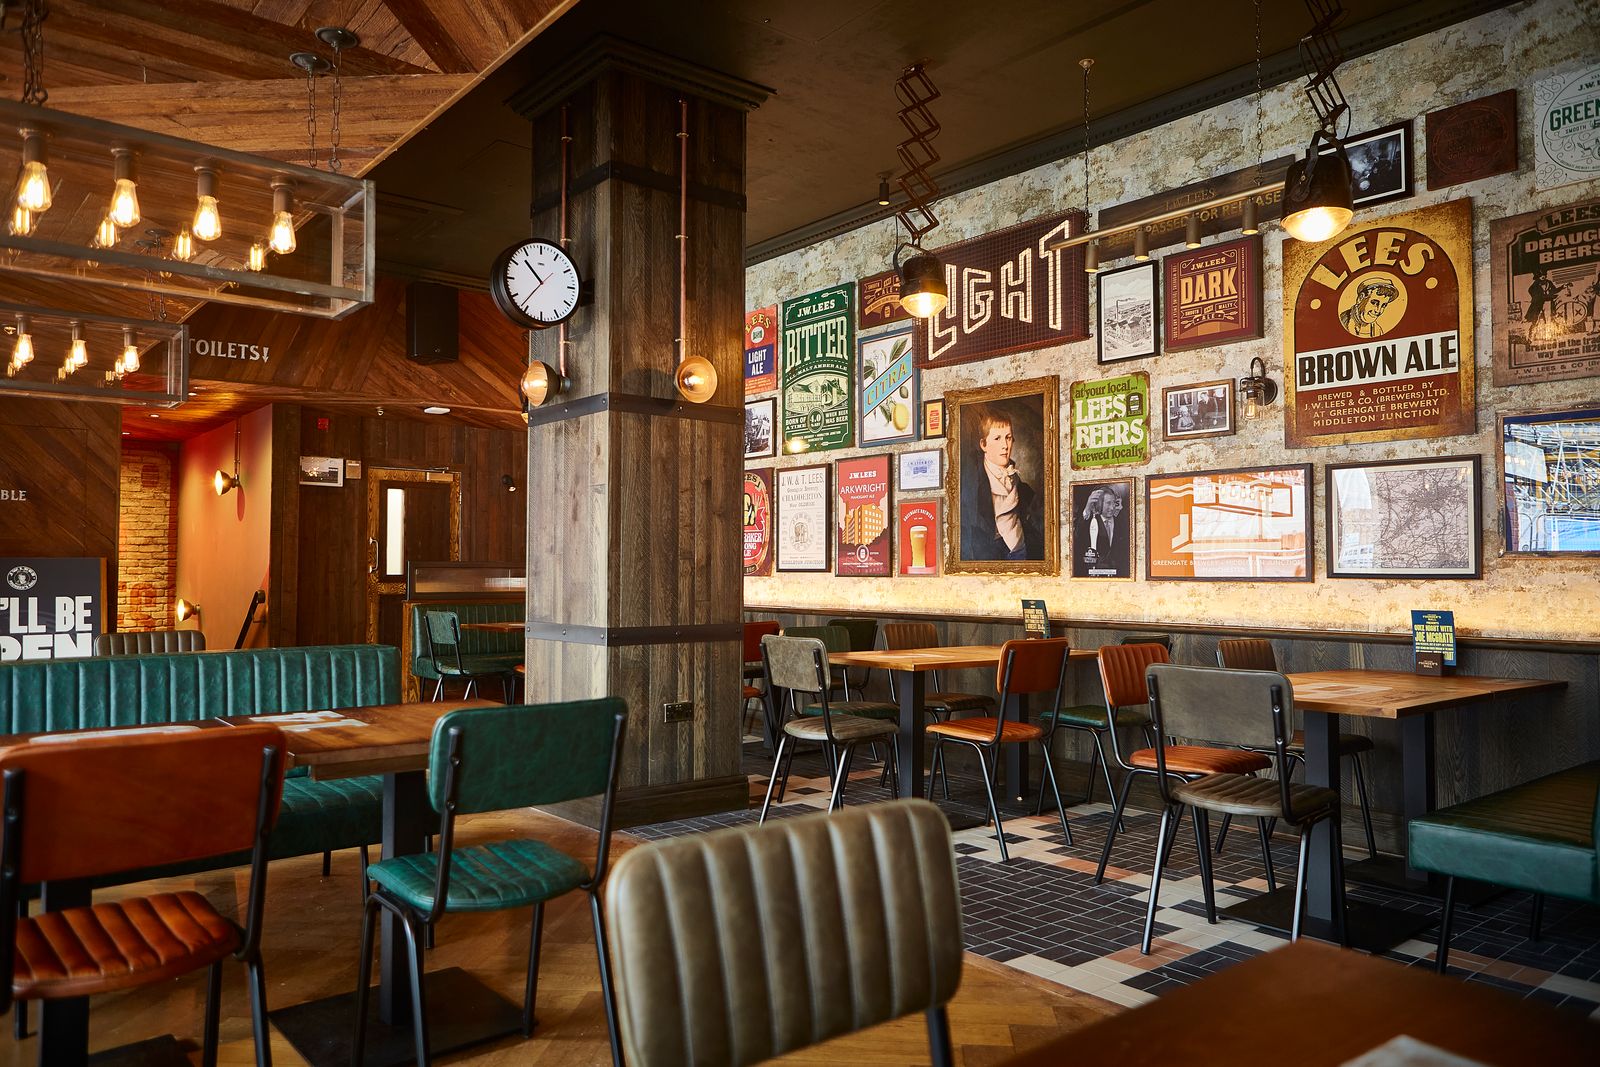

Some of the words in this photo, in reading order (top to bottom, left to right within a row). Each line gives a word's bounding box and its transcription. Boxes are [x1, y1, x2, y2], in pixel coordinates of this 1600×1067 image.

[1565, 124, 1587, 135] SMOOTH
[1222, 190, 1281, 217] RELASE
[1310, 231, 1435, 291] LEES
[927, 219, 1070, 361] LIGHT
[1180, 266, 1238, 305] DARK
[189, 338, 260, 361] TOILETS
[785, 316, 849, 373] BITTER
[1567, 339, 1581, 347] the
[748, 349, 767, 364] LIGHT
[1298, 343, 1398, 387] BROWN
[1404, 334, 1457, 374] ALE
[1537, 351, 1554, 359] way
[1557, 348, 1580, 357] since
[751, 363, 764, 376] ALE
[867, 361, 908, 406] CITRA
[1075, 387, 1083, 399] at
[1083, 386, 1106, 399] your
[1317, 391, 1353, 401] BREWED
[1359, 389, 1366, 397] &
[1372, 384, 1414, 395] BOTTLED
[1421, 381, 1434, 389] BY
[1348, 398, 1355, 406] &
[1357, 397, 1374, 405] CO.
[1376, 391, 1425, 404] (BREWERS)
[1427, 388, 1450, 397] LTD.
[1075, 393, 1127, 425] LEES
[1312, 410, 1325, 419] AT
[1329, 404, 1386, 417] GREENGATE
[1390, 398, 1439, 411] BREWERY
[1313, 414, 1376, 427] MIDDLETON
[1380, 407, 1440, 421] JUNCTION
[1075, 418, 1144, 451] BEERS
[1076, 448, 1109, 463] brewed
[1111, 445, 1144, 459] locally
[1, 489, 27, 501] BLE
[840, 482, 886, 494] ARKWRIGHT
[55, 595, 93, 633] BE
